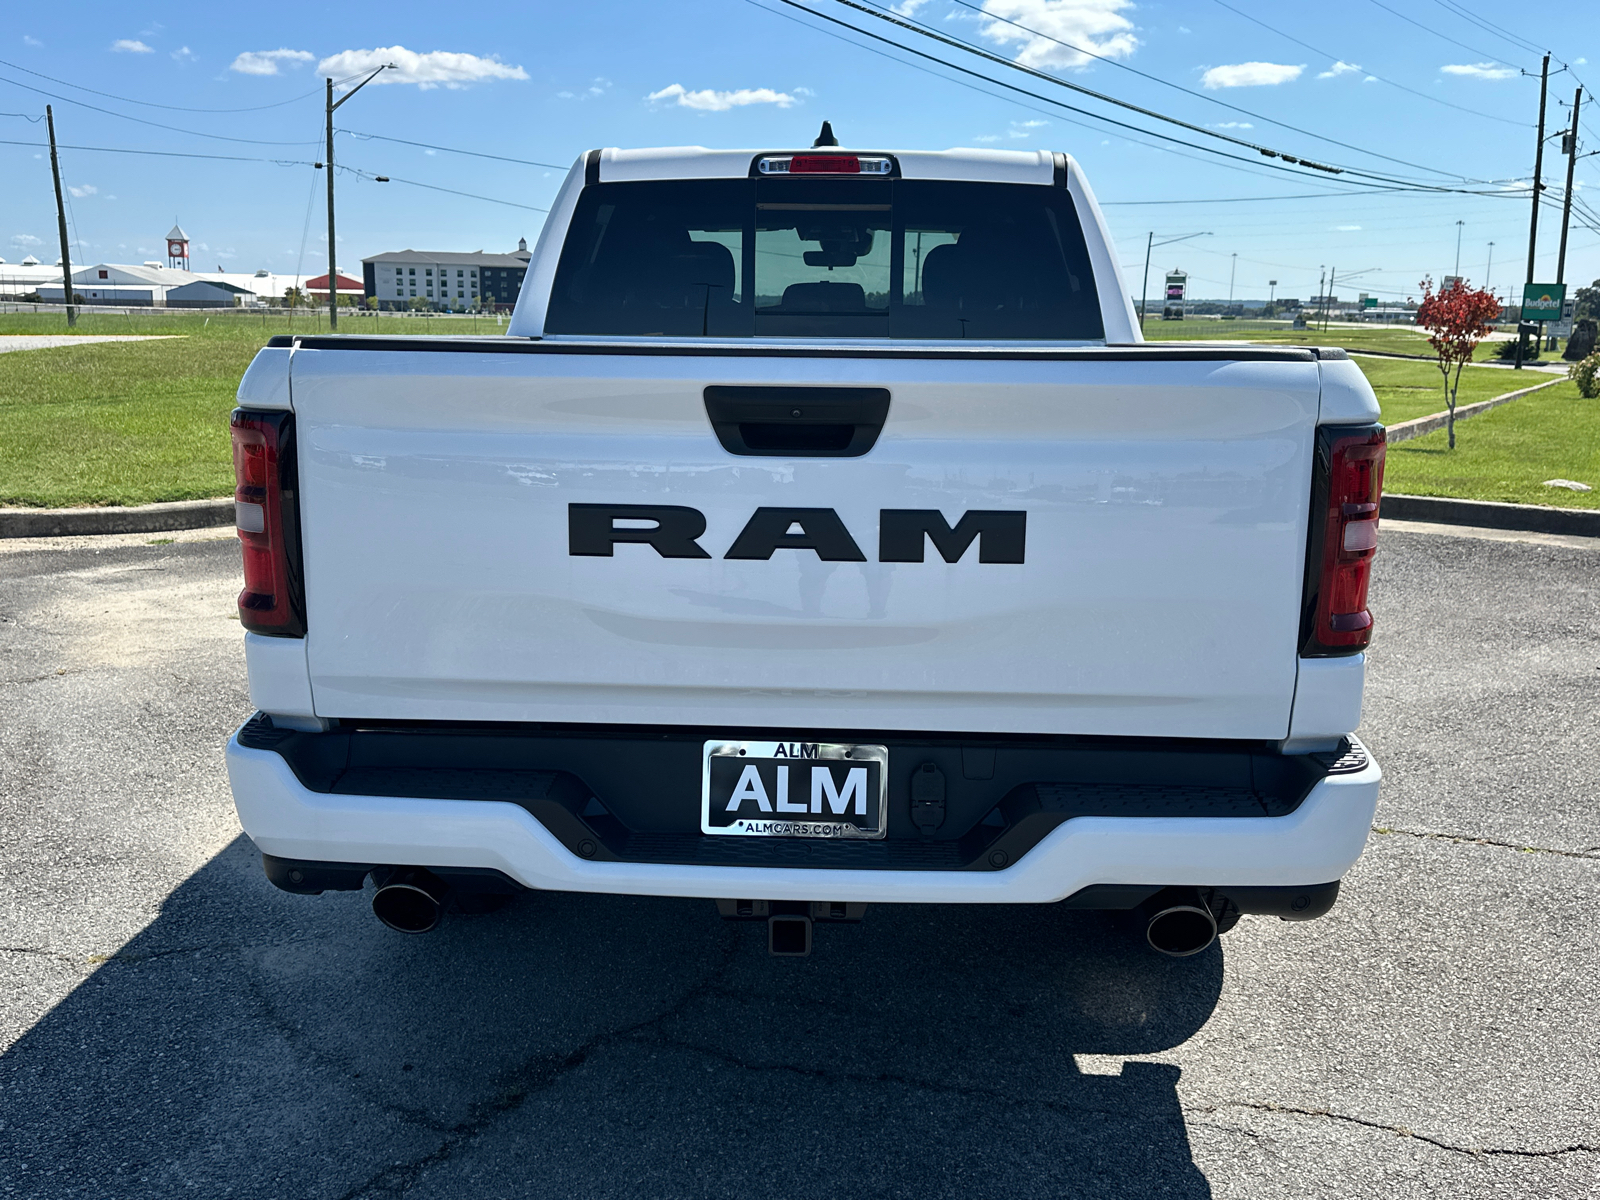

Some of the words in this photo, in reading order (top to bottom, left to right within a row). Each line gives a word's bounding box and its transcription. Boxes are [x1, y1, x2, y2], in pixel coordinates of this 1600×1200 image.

[1525, 298, 1560, 310] Budgetel
[568, 502, 1027, 564] RAM
[774, 742, 819, 759] ALM
[725, 764, 868, 815] ALM
[745, 822, 842, 837] ALMCARS.COM
